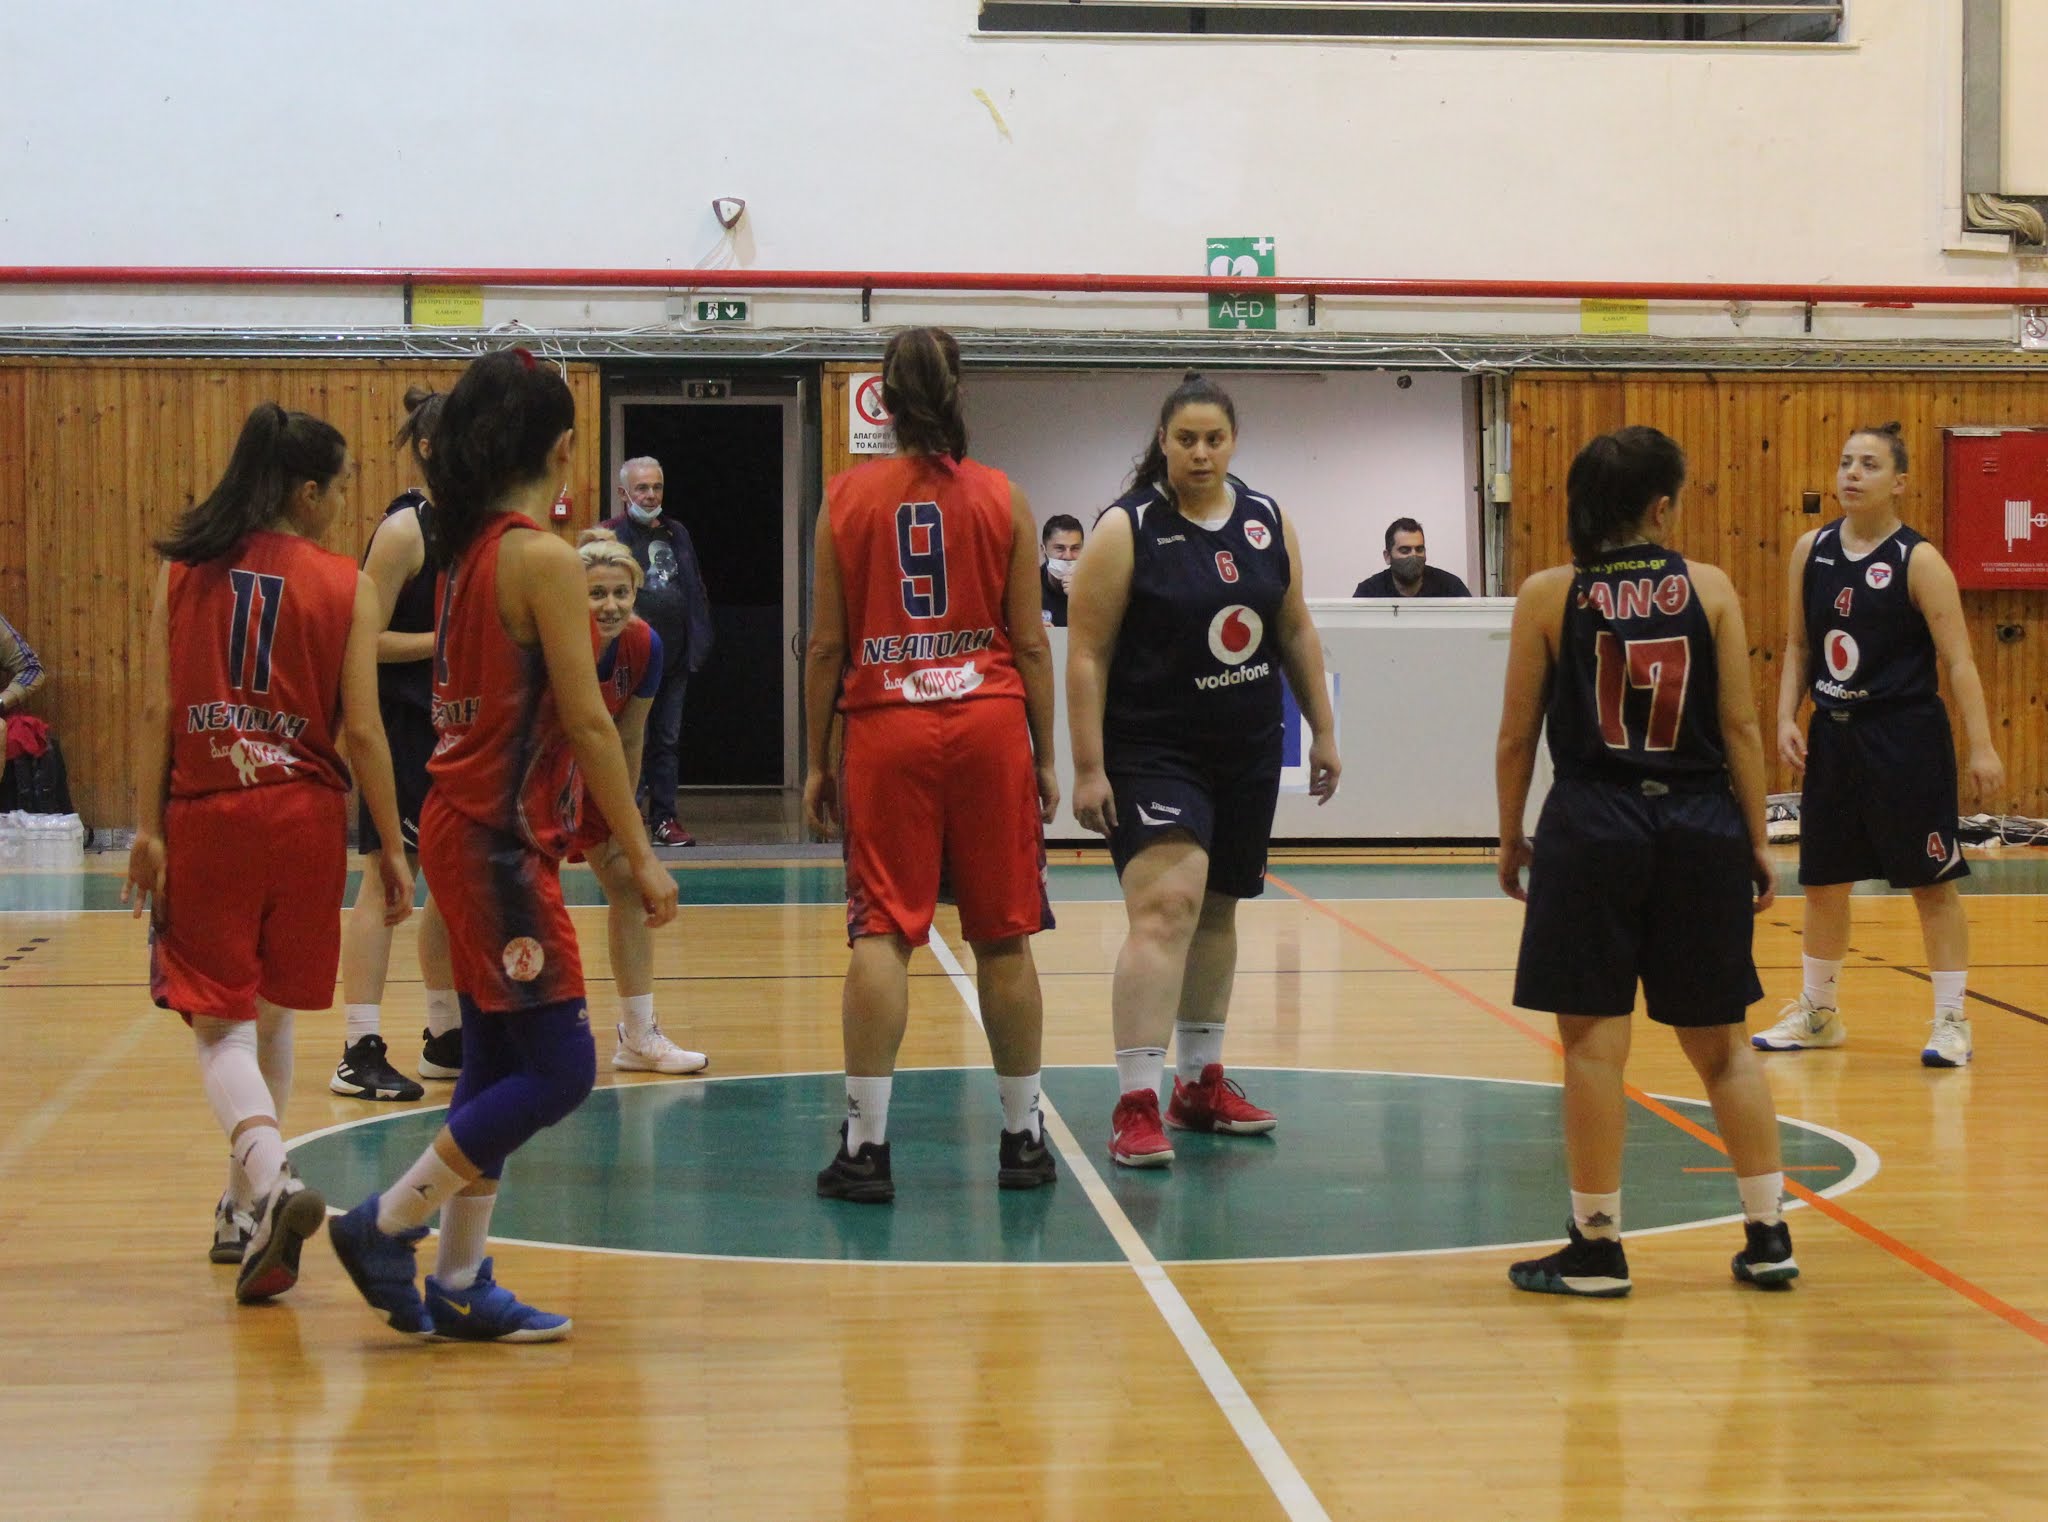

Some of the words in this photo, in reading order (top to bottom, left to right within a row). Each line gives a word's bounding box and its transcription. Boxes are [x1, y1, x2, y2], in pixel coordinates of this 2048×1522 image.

[1218, 301, 1264, 318] AED
[853, 432, 896, 440] ΑΠΑΓΟΡΕΥ
[895, 501, 949, 619] 9
[1215, 550, 1239, 584] 6
[1834, 587, 1853, 617] 4
[229, 569, 284, 694] 11
[862, 628, 994, 665] ΝΕΑΠΟΛΗ
[1195, 662, 1269, 690] vodafone
[1595, 631, 1690, 751] 17
[1927, 832, 1947, 862] 4
